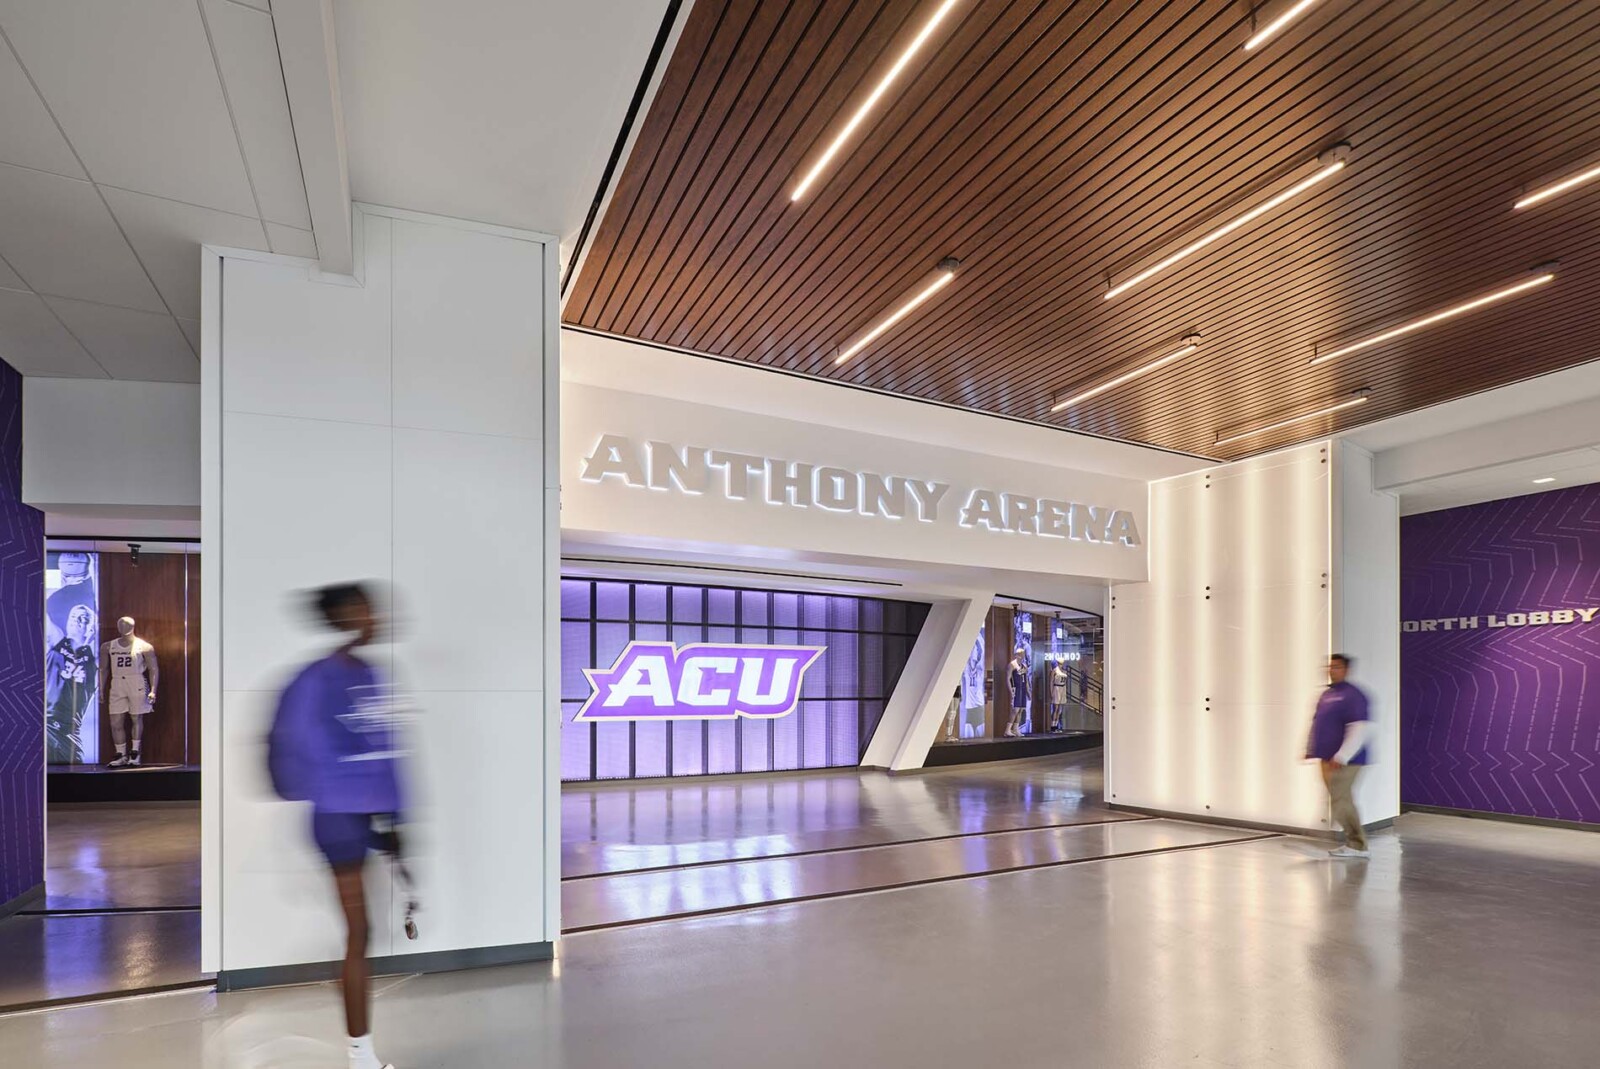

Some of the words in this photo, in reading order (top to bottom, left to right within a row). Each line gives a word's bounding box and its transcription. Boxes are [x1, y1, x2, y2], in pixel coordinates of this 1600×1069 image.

[580, 434, 950, 522] ANTHONY
[959, 489, 1142, 547] ARENA
[1400, 616, 1478, 633] ORTH
[1488, 607, 1600, 628] LOBBY
[60, 660, 86, 684] 34
[117, 657, 132, 668] 22
[602, 655, 799, 707] ACU
